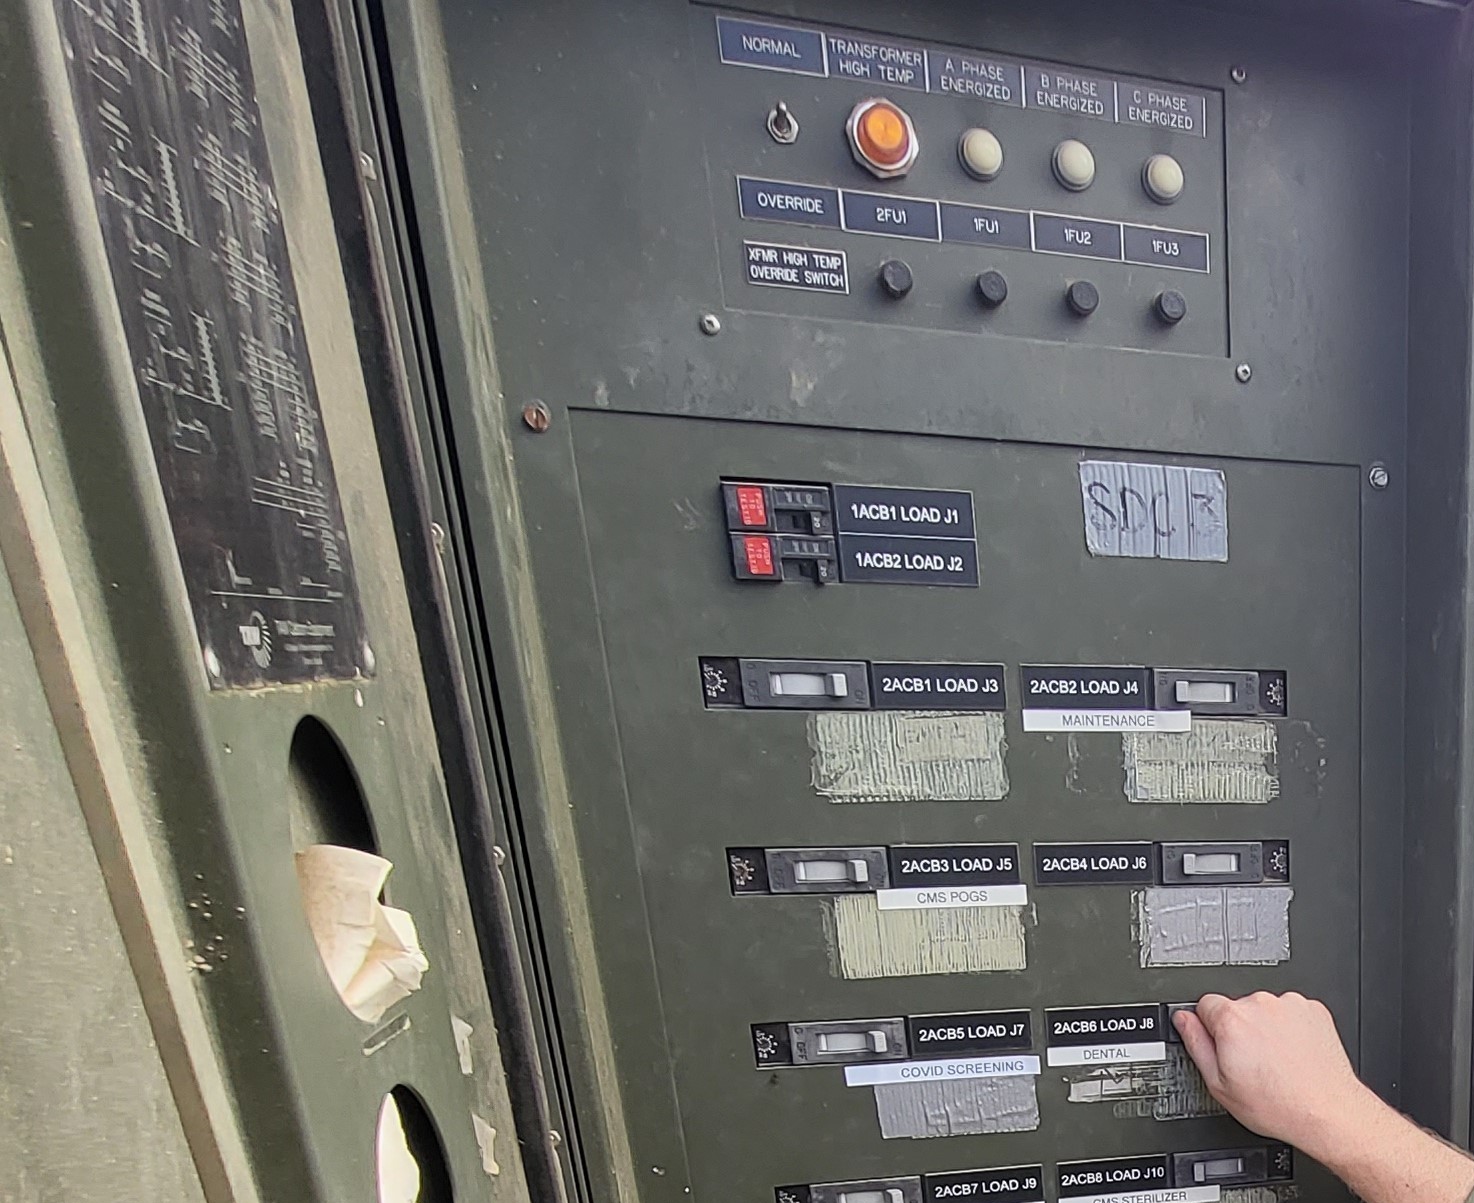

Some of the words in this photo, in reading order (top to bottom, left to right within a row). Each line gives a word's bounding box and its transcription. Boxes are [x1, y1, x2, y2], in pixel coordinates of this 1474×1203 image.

[742, 35, 801, 58] NORMAL
[829, 38, 922, 66] TRANSFORMER
[839, 59, 870, 78] HIGH
[877, 65, 914, 83] TEMP
[945, 58, 955, 72] A
[962, 61, 1004, 82] PHASE
[941, 75, 1011, 100] ENERGIZED
[1041, 74, 1050, 88] B
[1056, 77, 1097, 97] PHASE
[1036, 92, 1104, 115] ENERGIZED
[1133, 90, 1141, 104] C
[1148, 92, 1188, 112] PHASE
[1128, 107, 1193, 130] ENERGIZED
[757, 192, 824, 214] OVERRIDE
[876, 207, 907, 224] 2FU1
[973, 217, 999, 234] 1FU1
[1064, 228, 1092, 245] 1FU2
[1152, 240, 1179, 256] 1FU3
[749, 248, 778, 263] XFMR
[783, 252, 808, 266] HIGH
[813, 254, 841, 269] TEMP
[750, 266, 799, 283] OVERRIDE
[805, 271, 843, 287] SWITCH
[851, 503, 896, 520] 1ACB1
[900, 506, 940, 522] LOAD
[944, 508, 958, 524] J1
[856, 552, 901, 568] 1ACB2
[904, 554, 944, 570] LOAD
[947, 556, 963, 572] J2
[882, 677, 931, 693] 2ACB1
[936, 678, 978, 693] LOAD
[982, 679, 998, 693] J3
[1030, 679, 1077, 694] 2ACB2
[1081, 680, 1120, 694] LOAD
[1123, 680, 1138, 694] J4
[1062, 714, 1155, 727] MAINTENANCE
[902, 859, 948, 873] 2ACB3
[953, 858, 993, 872] LOAD
[996, 858, 1012, 871] J5
[1043, 857, 1088, 871] 2ACB4
[1091, 857, 1128, 870] LOAD
[1132, 857, 1147, 870] J6
[917, 892, 946, 904] CMS
[950, 890, 988, 902] POGS
[919, 1026, 965, 1042] 2ACB5
[968, 1024, 1006, 1039] LOAD
[1010, 1024, 1024, 1036] J7
[1054, 1020, 1097, 1034] 2ACB6
[1100, 1018, 1136, 1032] LOAD
[1139, 1018, 1154, 1030] J8
[1084, 1048, 1130, 1060] DENTAL
[901, 1066, 944, 1078] COVID
[947, 1061, 1024, 1075] SCREENING
[1061, 1172, 1102, 1187] 2ACB8
[1106, 1170, 1141, 1183] LOAD
[1144, 1166, 1165, 1180] J10
[934, 1184, 978, 1198] 2ACB7
[982, 1179, 1019, 1194] LOAD
[1022, 1178, 1037, 1190] J9
